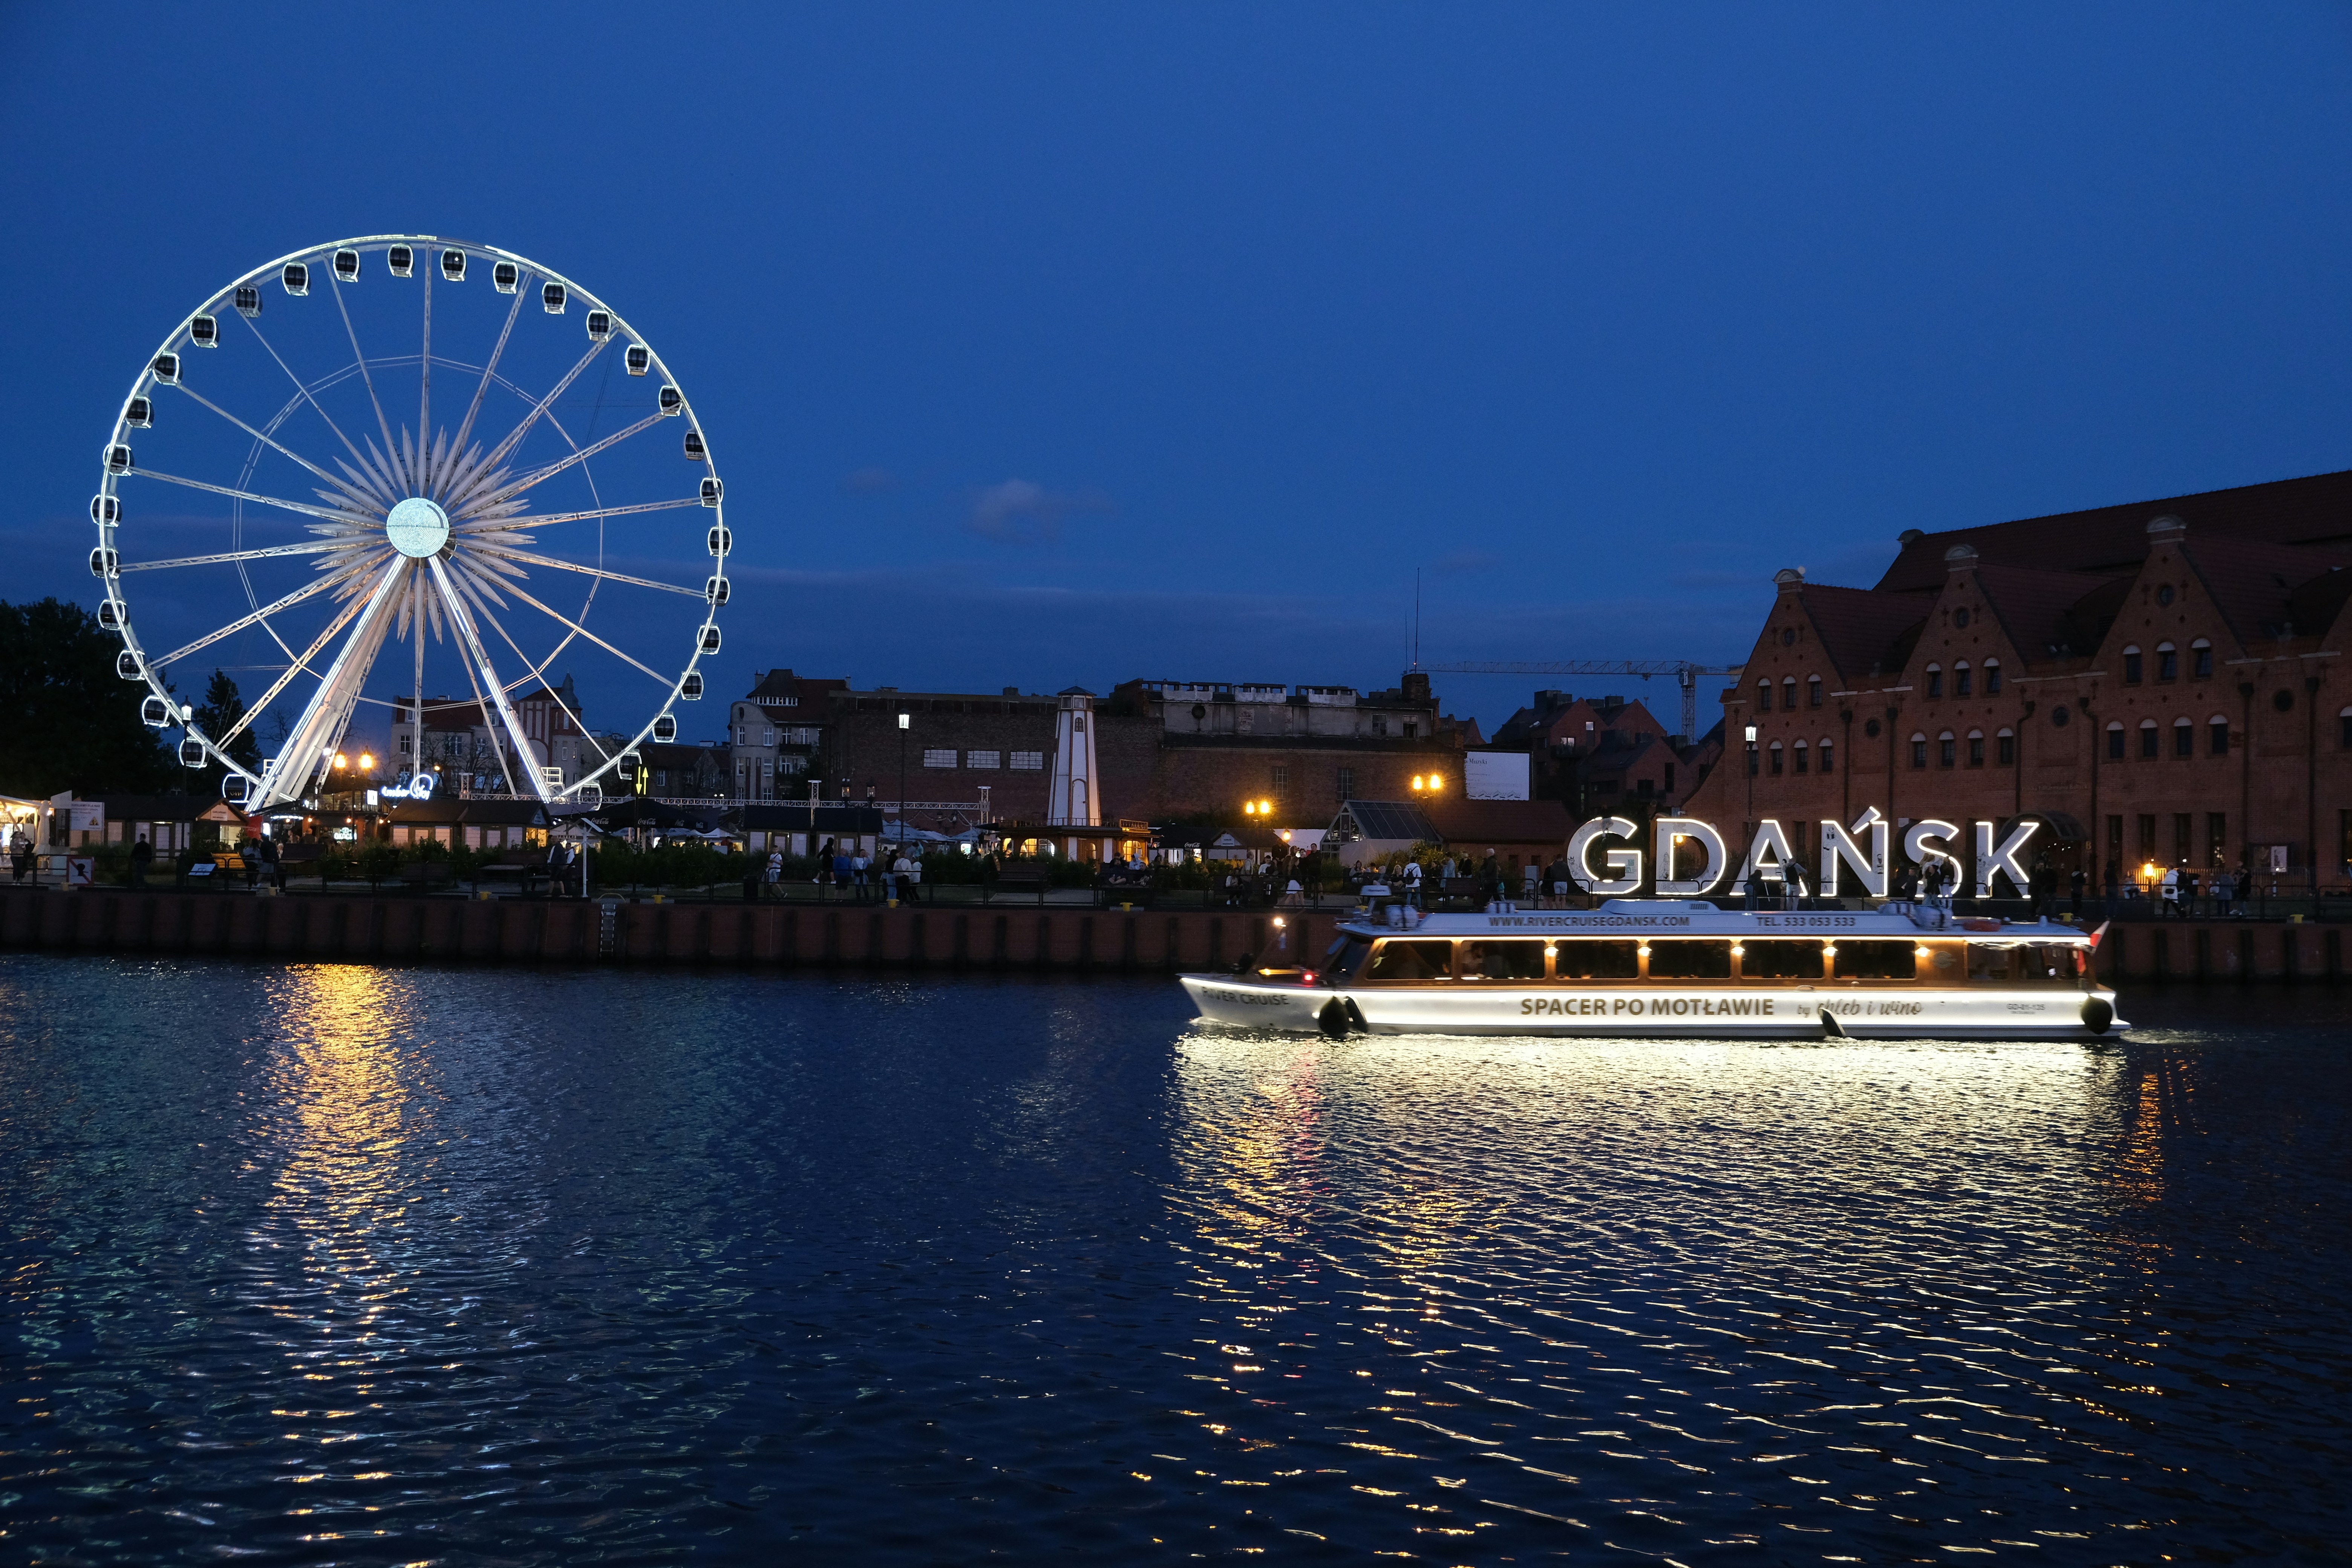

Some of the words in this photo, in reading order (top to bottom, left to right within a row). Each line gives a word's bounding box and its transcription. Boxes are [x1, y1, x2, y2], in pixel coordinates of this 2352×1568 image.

[1567, 806, 2039, 899] GDAŃSK
[1488, 917, 1690, 926] WWW.RIVERCRUISEGDANSK.COM
[1756, 917, 1781, 926] TEL.
[1784, 917, 1805, 926] 533
[1810, 917, 1830, 926] 053
[1834, 917, 1856, 926] 533
[1202, 986, 1238, 1003] RIVER
[1240, 994, 1290, 1005] CRUISE
[1521, 998, 1607, 1015] SPACER
[1613, 998, 1645, 1015] PO
[1651, 998, 1775, 1015] MOTŁAWIE
[1880, 1001, 1923, 1015] wino
